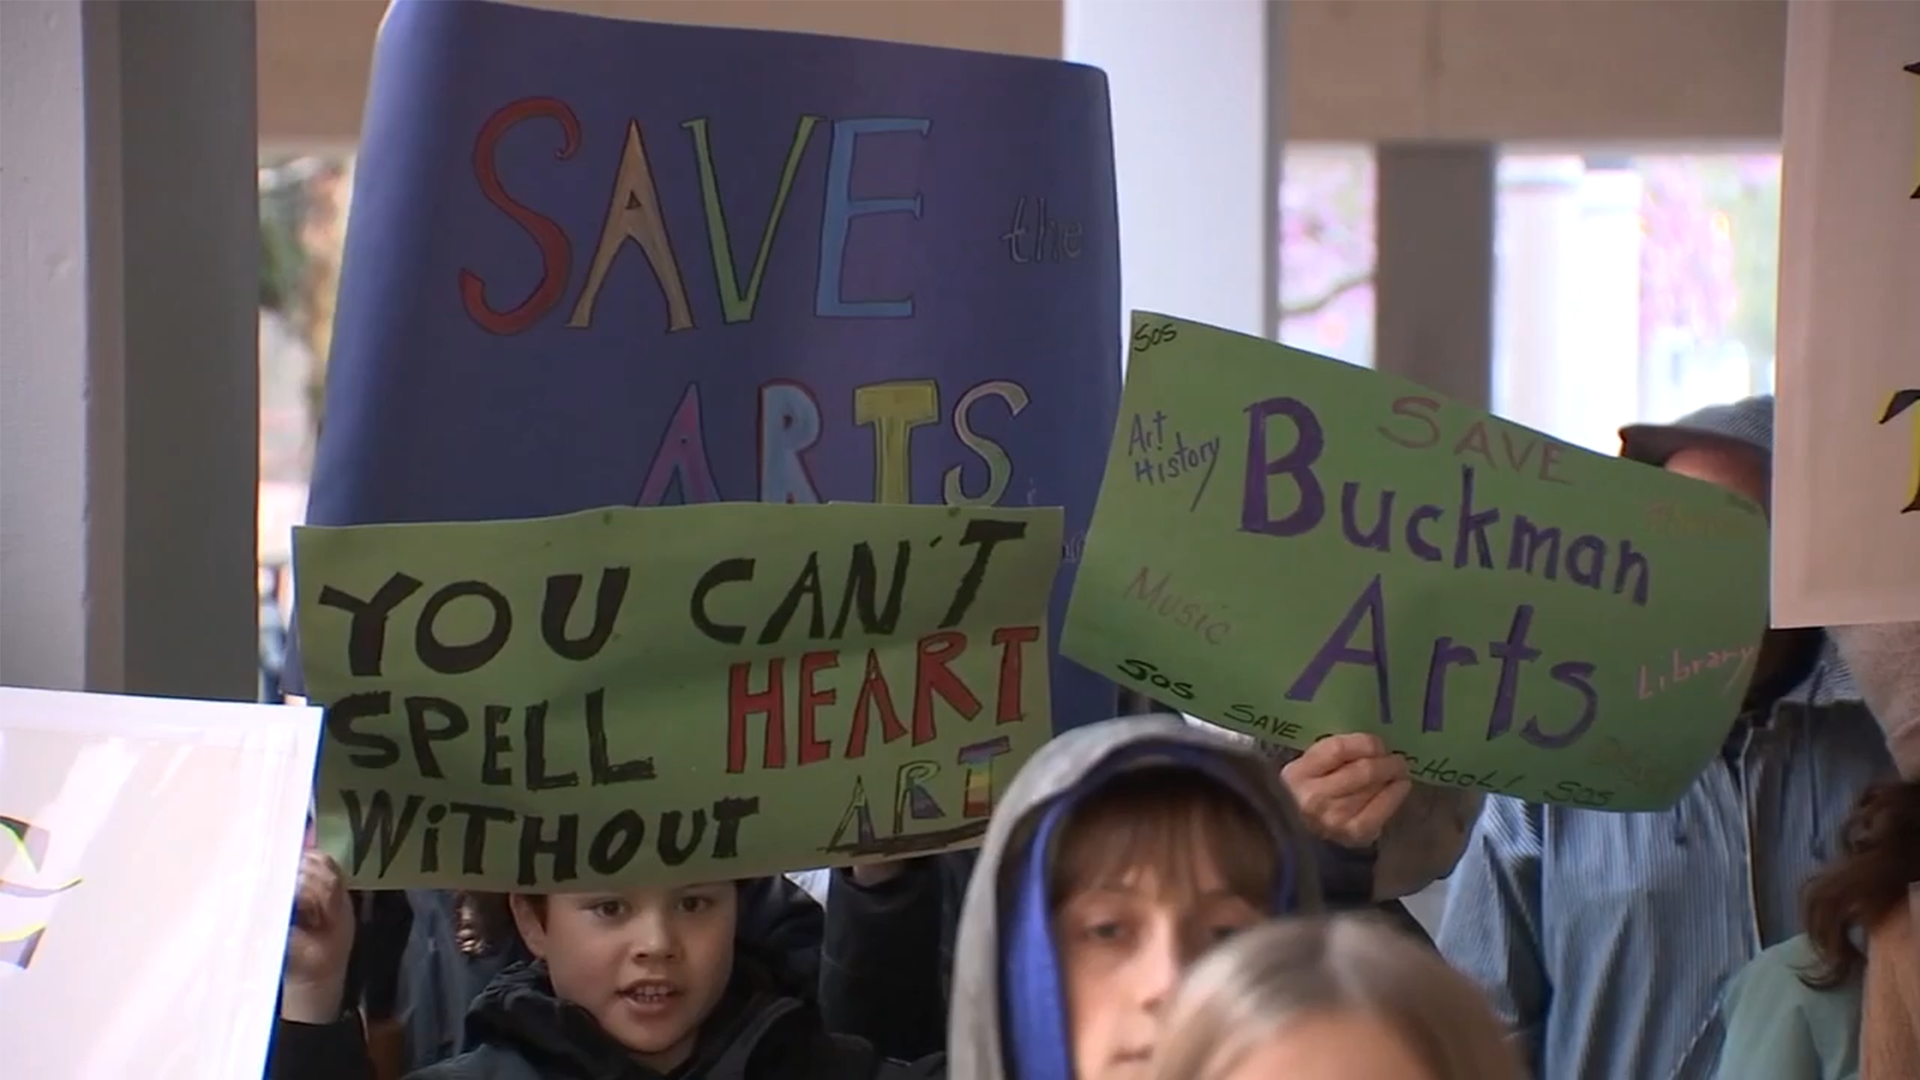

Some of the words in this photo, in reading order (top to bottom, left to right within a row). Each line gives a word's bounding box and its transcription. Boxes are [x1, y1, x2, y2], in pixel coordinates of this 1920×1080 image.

[459, 97, 932, 335] SAVE
[998, 195, 1083, 264] the
[635, 378, 1029, 506] ARTS
[1128, 411, 1167, 456] Art
[1134, 432, 1220, 512] History
[1377, 396, 1573, 485] SAVE
[1236, 396, 1650, 606] Buckman
[319, 566, 631, 678] YOU
[690, 519, 1027, 644] CAN'T
[1123, 566, 1231, 645] Music
[325, 689, 657, 790] SPELL
[725, 627, 1040, 775] HEART
[1284, 574, 1599, 749] Arts
[1638, 645, 1758, 699] Library
[1223, 704, 1302, 740] SAVE
[826, 736, 1012, 852] ART
